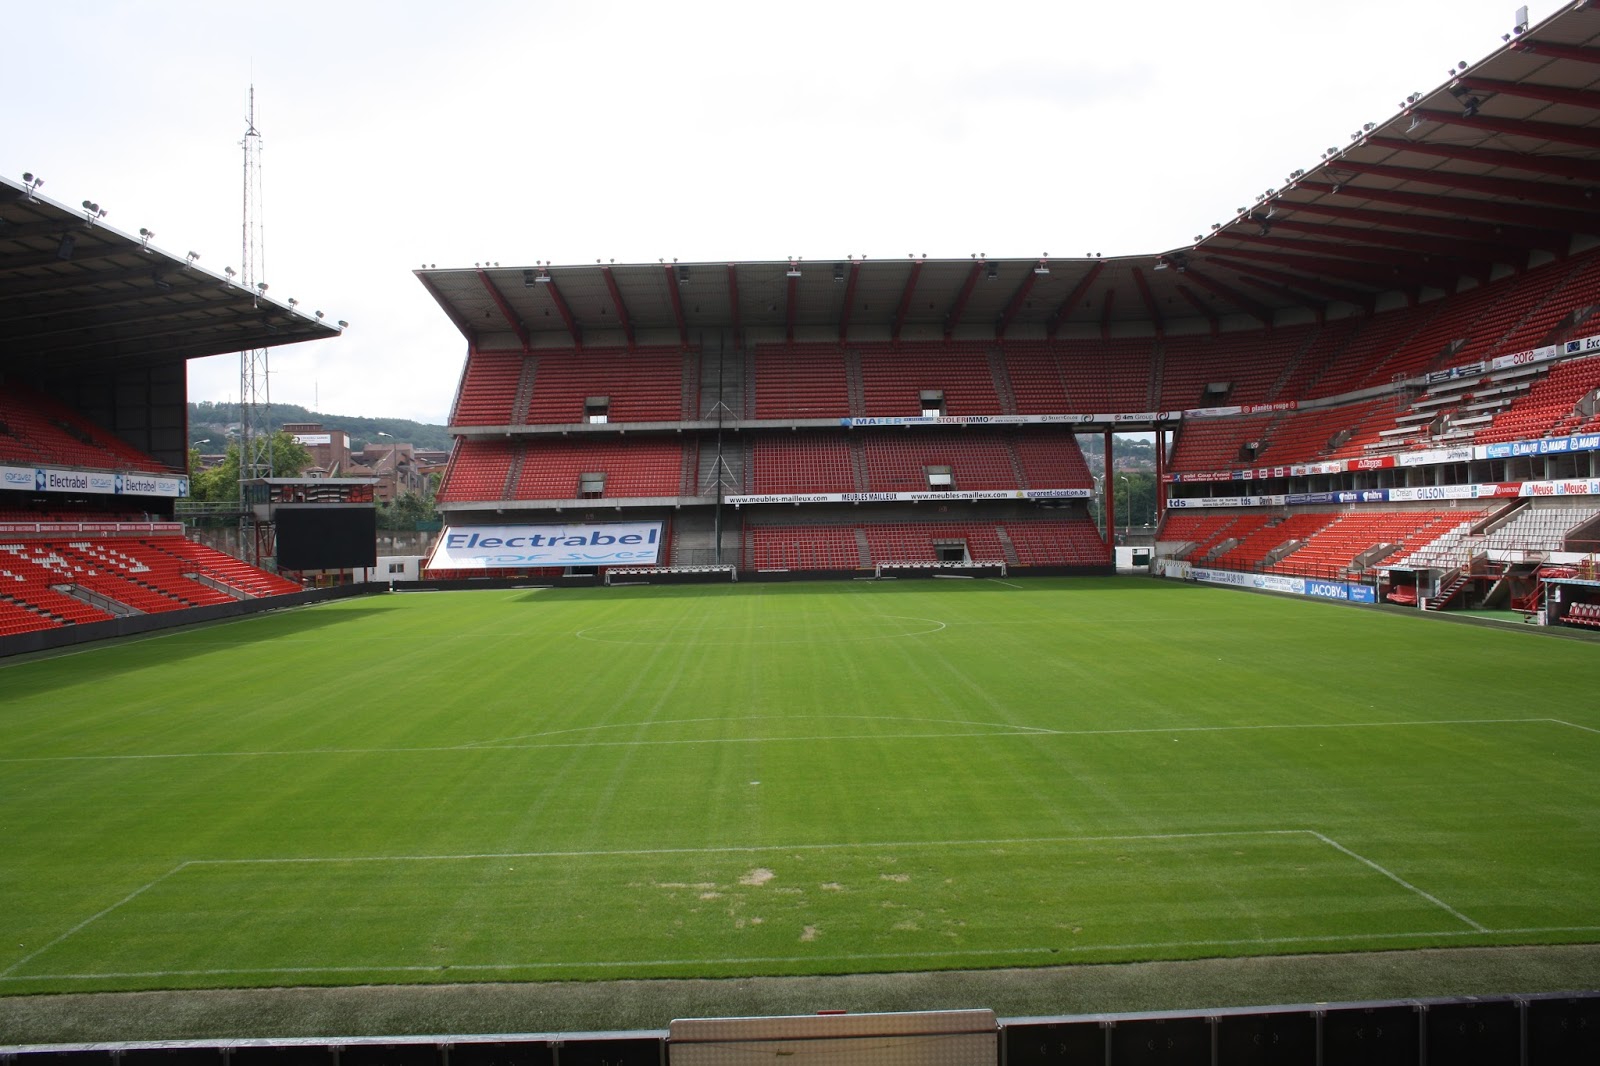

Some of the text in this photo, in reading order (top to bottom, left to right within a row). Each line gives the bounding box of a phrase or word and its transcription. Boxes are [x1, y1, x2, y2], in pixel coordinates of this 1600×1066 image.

[1513, 350, 1534, 365] cora
[1251, 401, 1289, 413] planète rouge
[855, 417, 902, 425] MAFER
[936, 416, 989, 424] STOLERIMMO
[1549, 440, 1567, 451] MAPEI
[1579, 436, 1600, 448] MAPEI
[1520, 443, 1538, 453] MAPEI
[1363, 459, 1382, 468] Kappa
[49, 474, 88, 488] Electrabel
[126, 479, 156, 492] Electrabel
[841, 493, 868, 501] MEUBLES
[910, 491, 1008, 499] www.meubles-mailleux.com
[1026, 489, 1087, 498] eurorent-location.be
[1416, 487, 1445, 499] GILSON
[729, 495, 828, 503] www.meubles-mailleux.com
[1169, 499, 1186, 507] tds
[1241, 497, 1251, 506] tds
[446, 528, 657, 549] Electrabel
[1310, 583, 1348, 598] JACOBY.be
